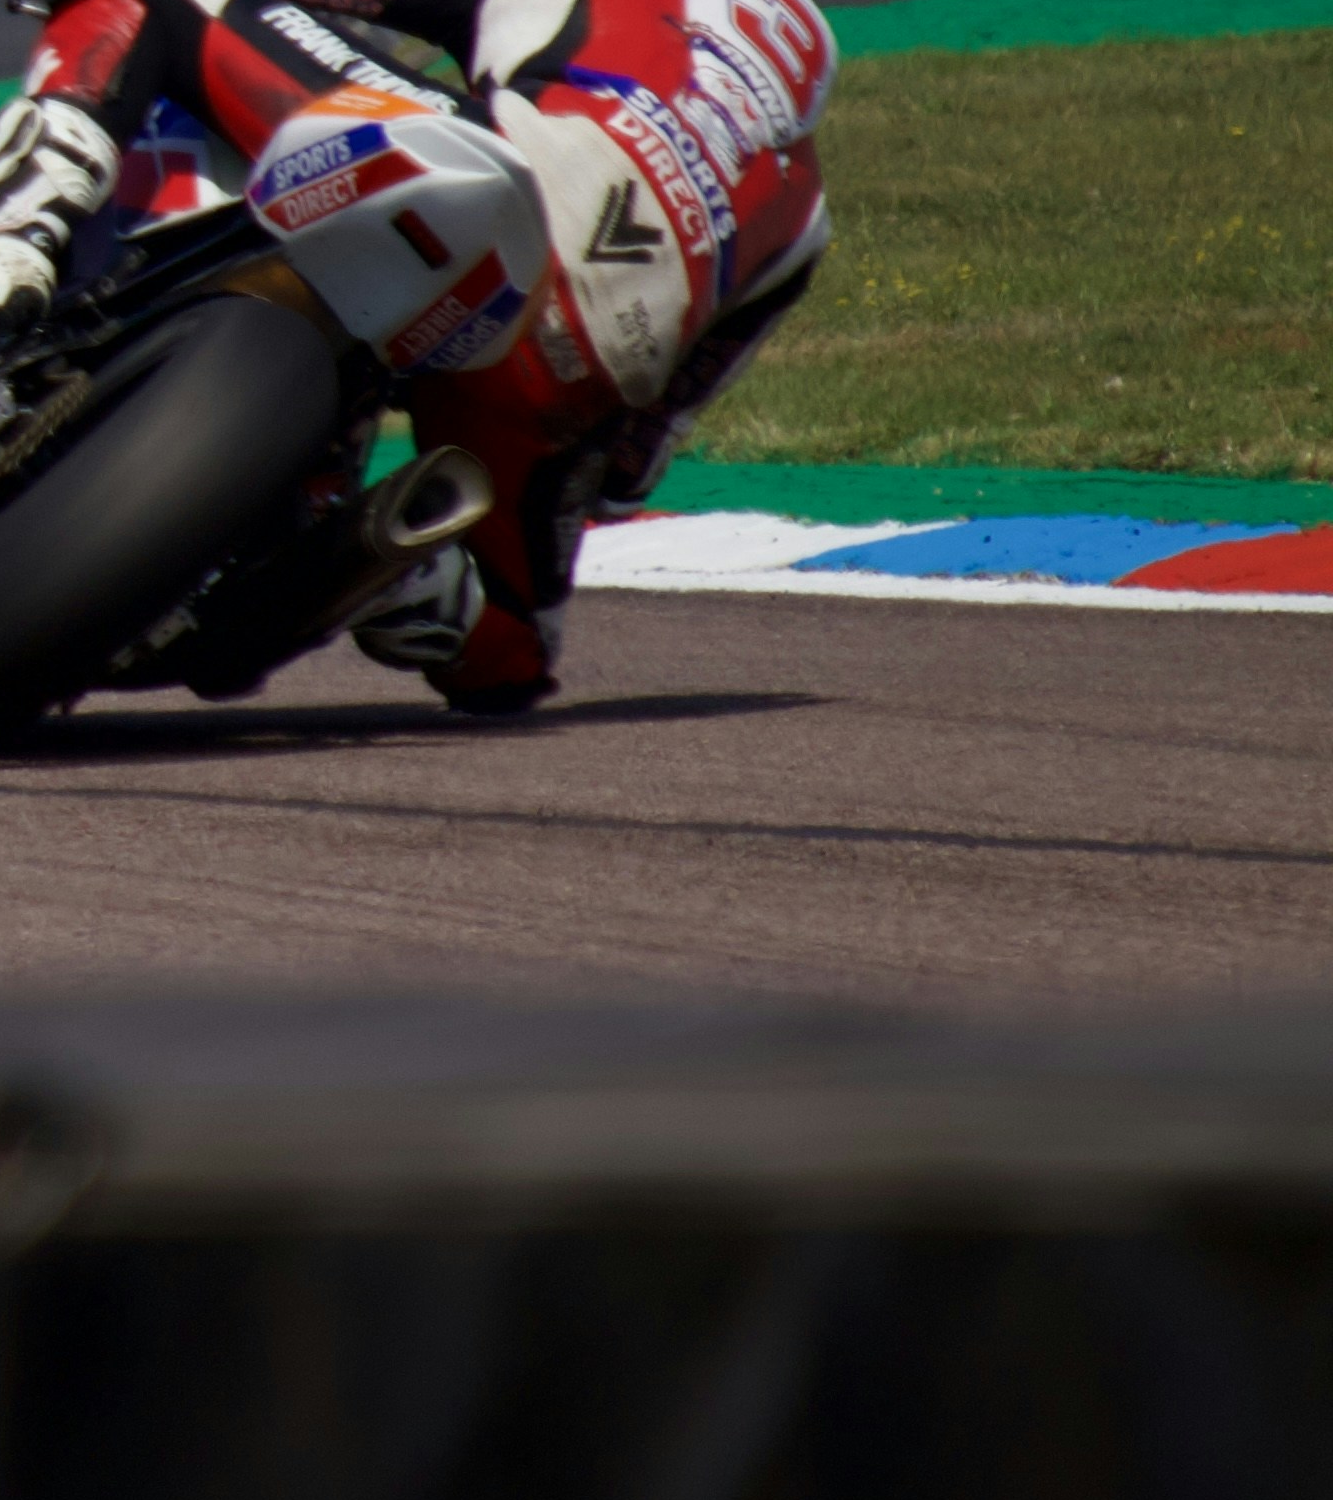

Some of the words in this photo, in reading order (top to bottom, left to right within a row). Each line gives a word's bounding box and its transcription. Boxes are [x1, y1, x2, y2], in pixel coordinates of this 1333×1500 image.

[260, 3, 365, 73] FRANK
[271, 132, 353, 192] SPORTS
[607, 106, 713, 257] DIRECT
[633, 85, 737, 243] SPORTS
[282, 169, 362, 227] DIRECT
[396, 295, 471, 353] DIRECT
[426, 313, 502, 369] SPORTS
